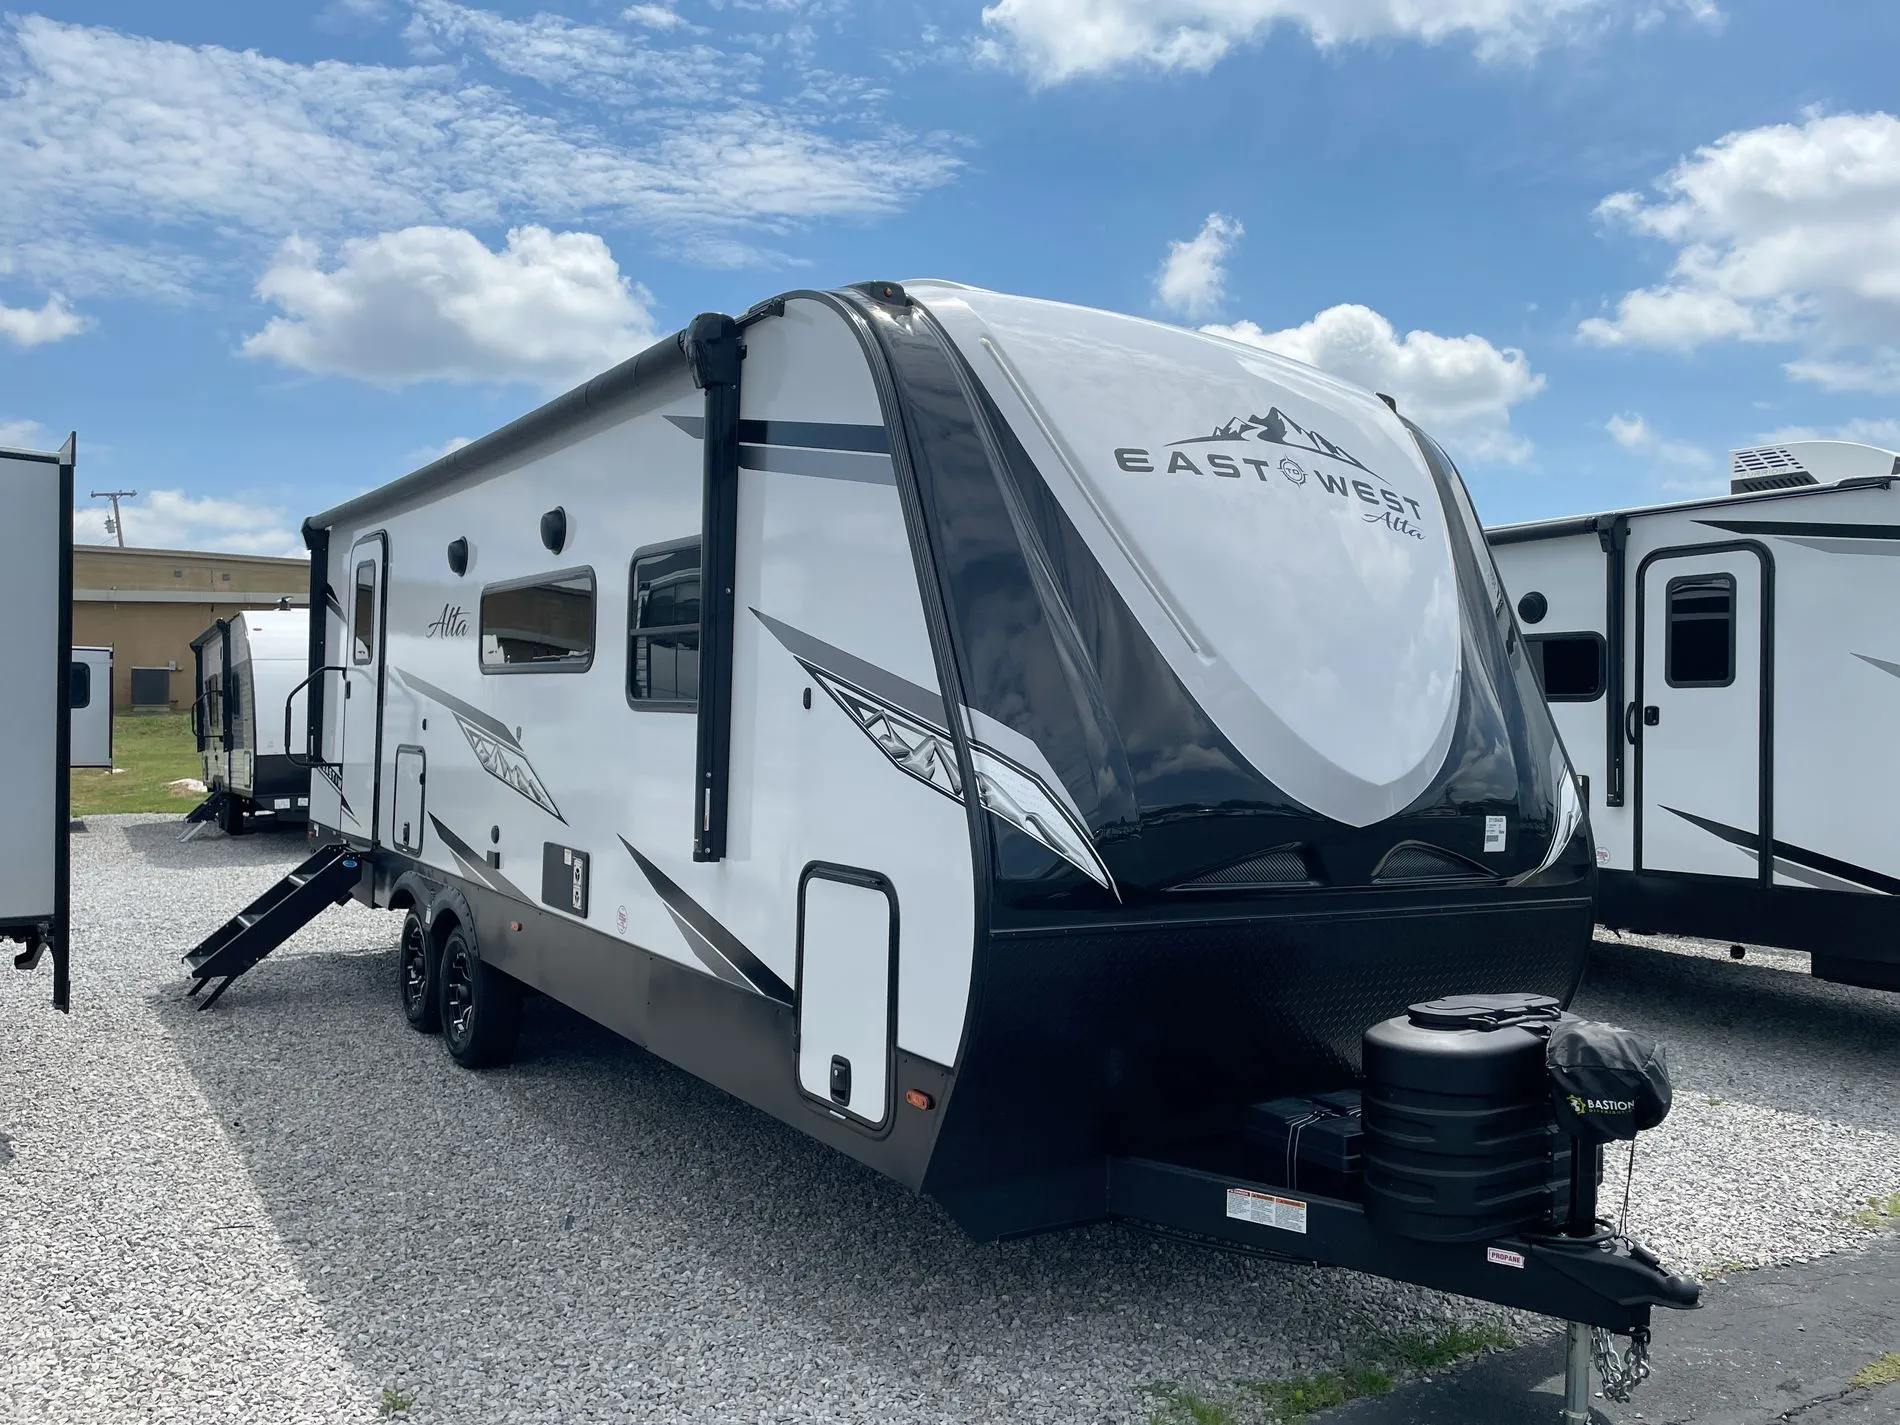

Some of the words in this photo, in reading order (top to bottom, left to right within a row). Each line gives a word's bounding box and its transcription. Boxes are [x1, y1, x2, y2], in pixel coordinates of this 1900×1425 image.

[1740, 467, 1787, 478] FURRION
[1113, 447, 1269, 482] EAST
[1285, 467, 1300, 475] TO
[1313, 469, 1422, 521] WEST
[1361, 511, 1425, 541] Alta
[425, 603, 471, 639] Alta
[1587, 1099, 1635, 1111] BASTION
[1491, 1252, 1521, 1264] PROPANE
